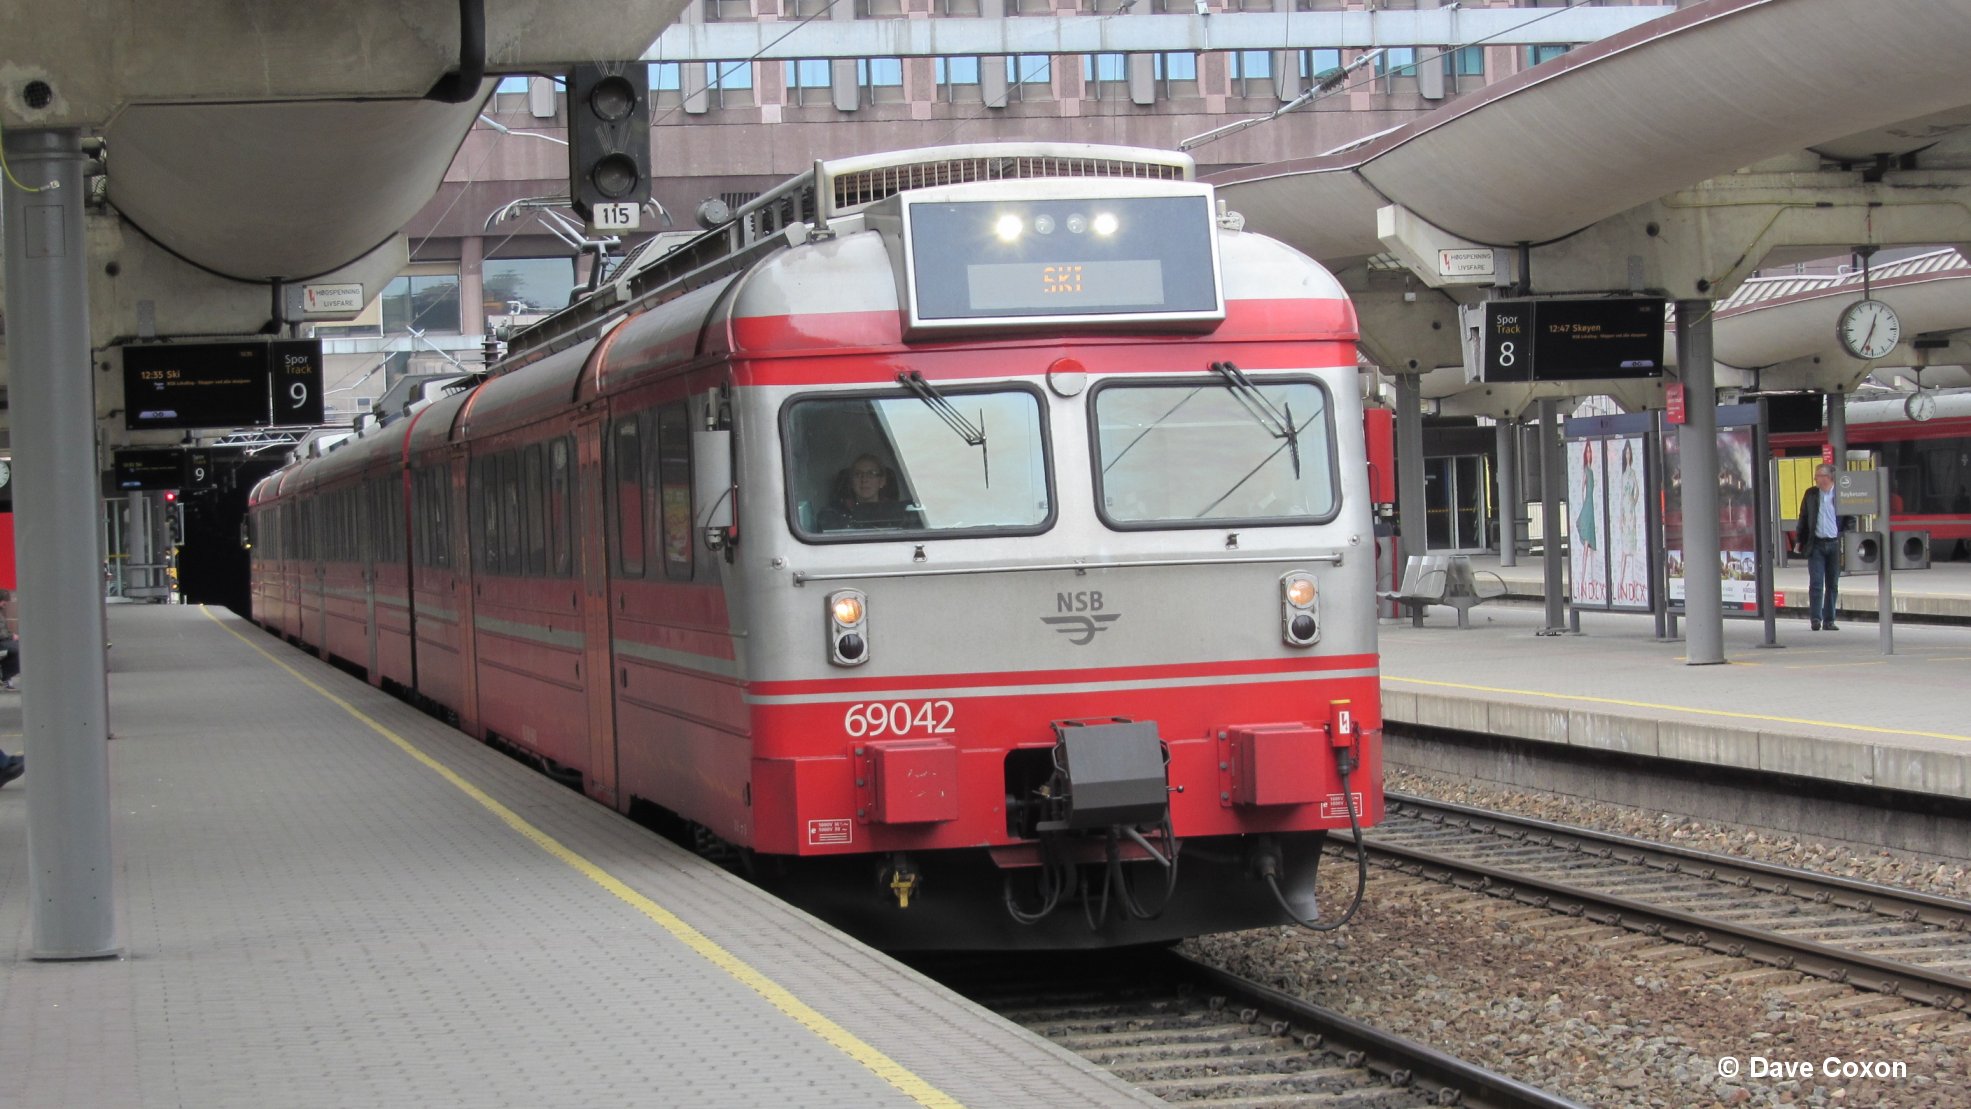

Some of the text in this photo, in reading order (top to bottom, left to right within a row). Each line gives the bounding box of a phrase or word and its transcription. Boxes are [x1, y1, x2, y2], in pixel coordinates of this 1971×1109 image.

[603, 208, 629, 224] 115
[1043, 265, 1082, 293] SKI
[1496, 314, 1518, 325] Spor
[1496, 324, 1521, 334] Track
[1549, 324, 1570, 333] 12:47
[284, 354, 309, 365] Spor
[1499, 341, 1515, 366] 8
[141, 370, 181, 379] 12:35 Ski
[285, 364, 313, 375] Track
[290, 382, 308, 409] 9
[195, 467, 205, 481] 9
[1572, 581, 1606, 600] LINDEX
[1612, 581, 1648, 602] LINDEX
[1057, 590, 1104, 612] NSB
[844, 700, 956, 737] 69042
